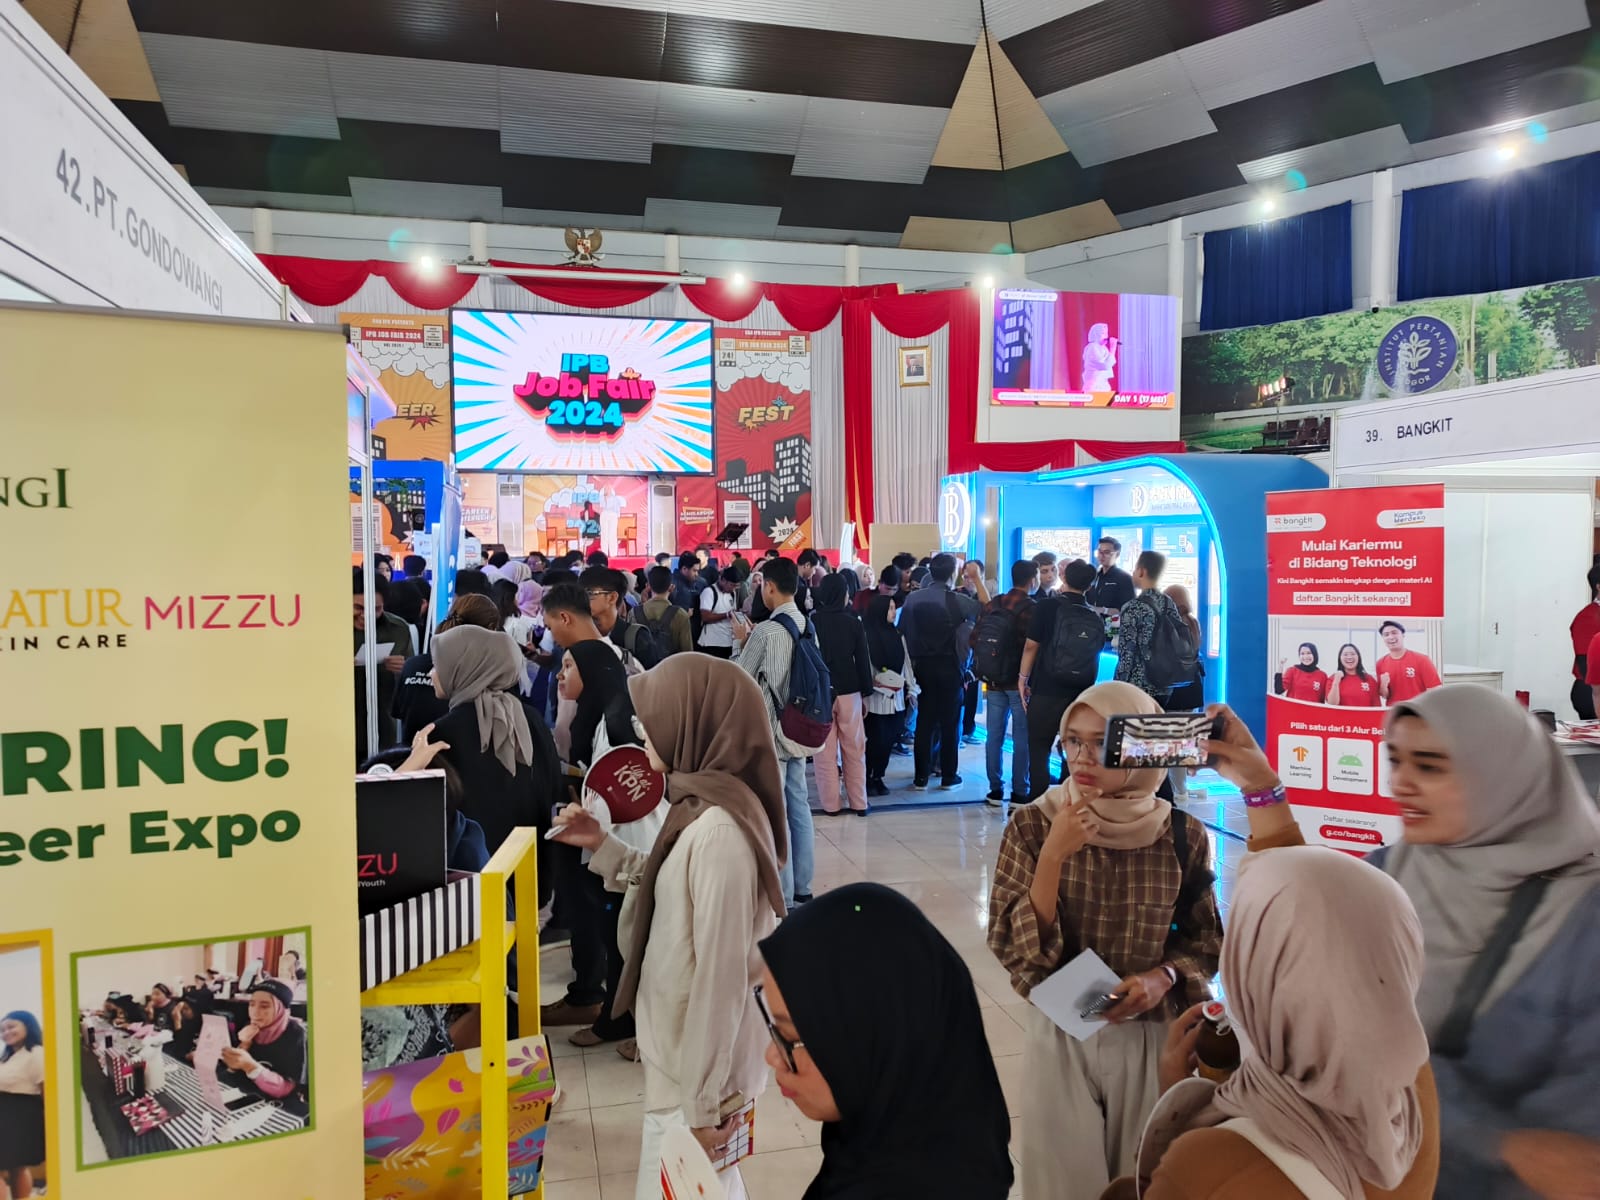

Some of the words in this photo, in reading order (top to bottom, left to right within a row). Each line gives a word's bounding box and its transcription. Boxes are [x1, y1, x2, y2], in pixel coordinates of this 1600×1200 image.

[561, 353, 609, 374] IPB
[513, 371, 583, 398] Job
[587, 373, 657, 401] Fair
[1114, 394, 1131, 403] DAY
[1133, 394, 1138, 403] 1
[546, 399, 624, 427] 2024
[738, 405, 795, 423] FEST
[1366, 429, 1383, 443] 39.
[1397, 417, 1453, 439] BANGKIT
[1302, 539, 1336, 552] Mulai
[1340, 539, 1403, 551] Kariermu
[1289, 557, 1300, 569] di
[1303, 556, 1348, 571] Bidang
[1351, 555, 1417, 570] Teknologi
[1296, 593, 1323, 603] daftar
[1325, 593, 1360, 604] Bangkit
[1362, 593, 1409, 604] sekarang!
[144, 593, 301, 631] MIZZU
[56, 633, 127, 650] CARE
[1290, 721, 1308, 730] Pilih
[1309, 724, 1327, 732] satu
[1328, 725, 1344, 733] dari
[1352, 726, 1370, 735] Alur
[1, 717, 290, 796] RING!
[613, 764, 646, 803] KPN
[129, 809, 301, 859] Expo
[1326, 829, 1376, 841] g.co/bangkit
